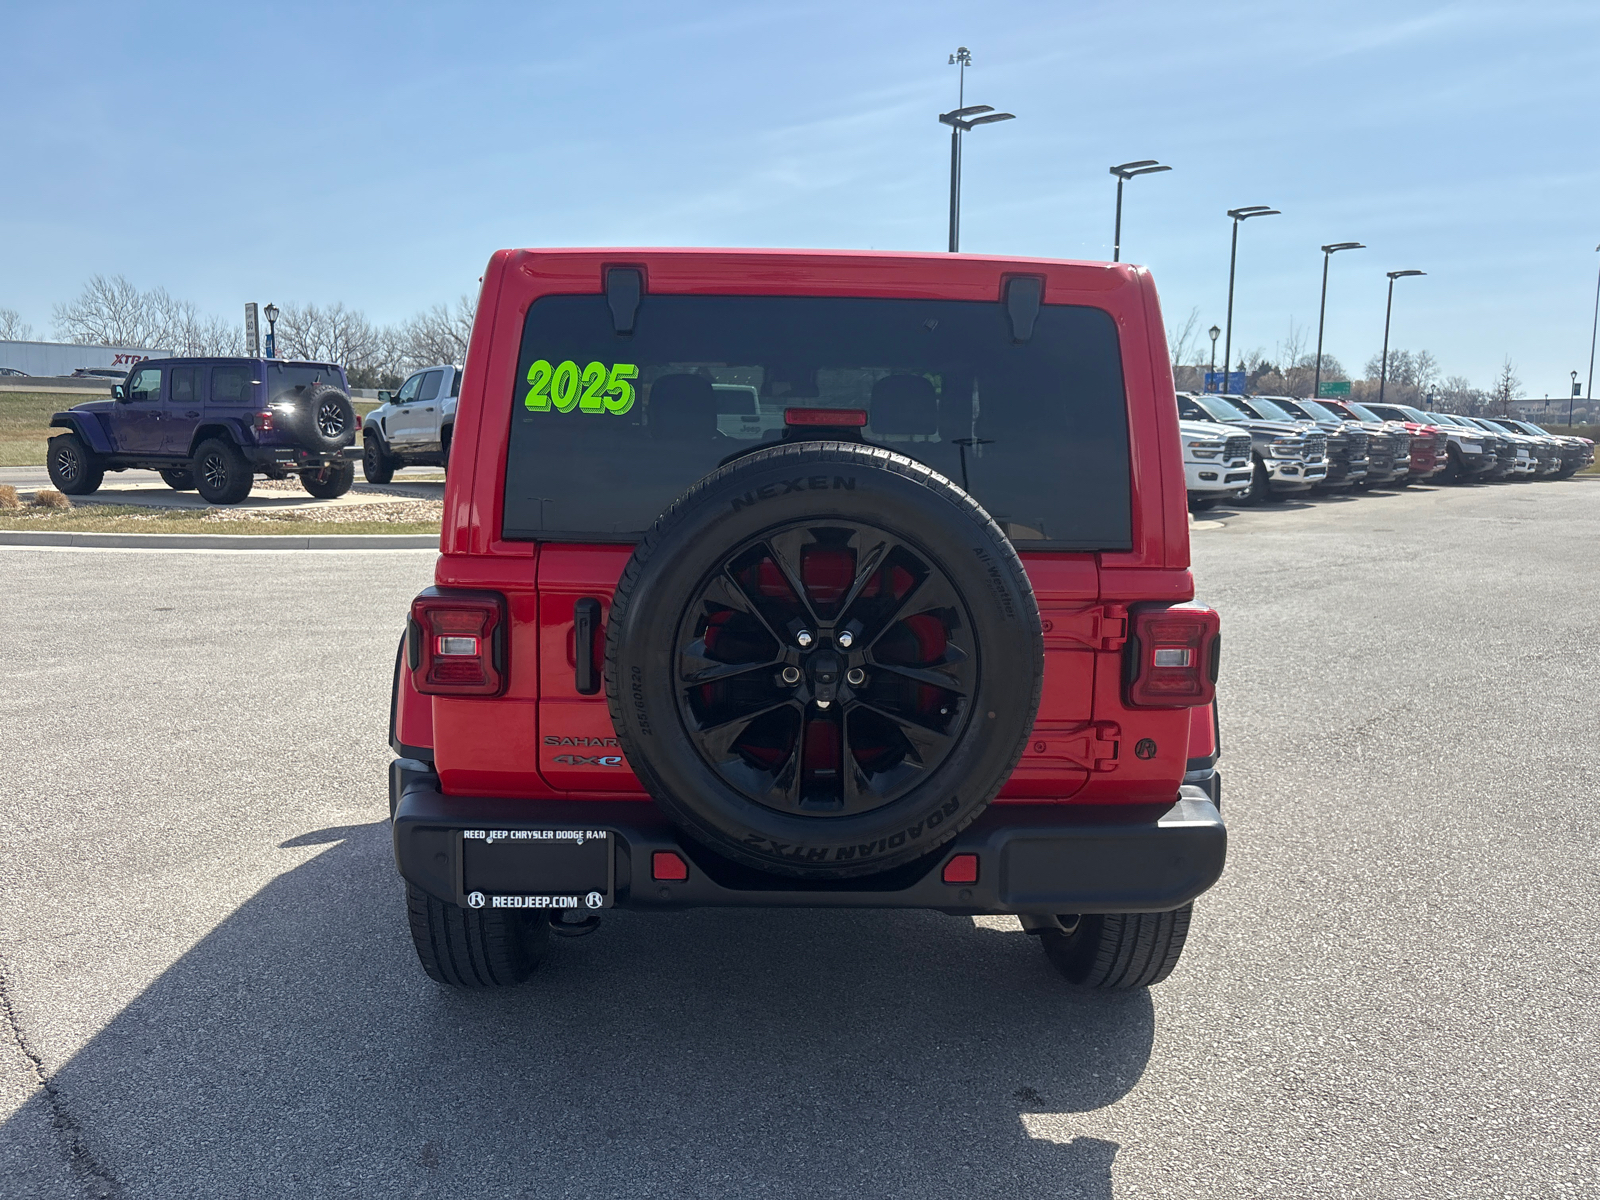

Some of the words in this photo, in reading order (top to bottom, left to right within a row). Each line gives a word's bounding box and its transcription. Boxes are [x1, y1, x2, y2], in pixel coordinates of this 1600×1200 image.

[525, 359, 639, 415] 2025
[731, 475, 856, 512] NEXEN
[973, 547, 1014, 618] All-Weather
[631, 666, 653, 736] 255/60R20
[543, 736, 621, 747] SAHAR
[463, 830, 486, 839] REED
[489, 830, 508, 839] JEEP
[510, 830, 553, 840] CHRYSLER
[555, 831, 584, 839] DODGE
[586, 831, 607, 839] RAM
[837, 796, 960, 860] ROADIAN
[492, 896, 578, 908] REEDJEEP.COM
